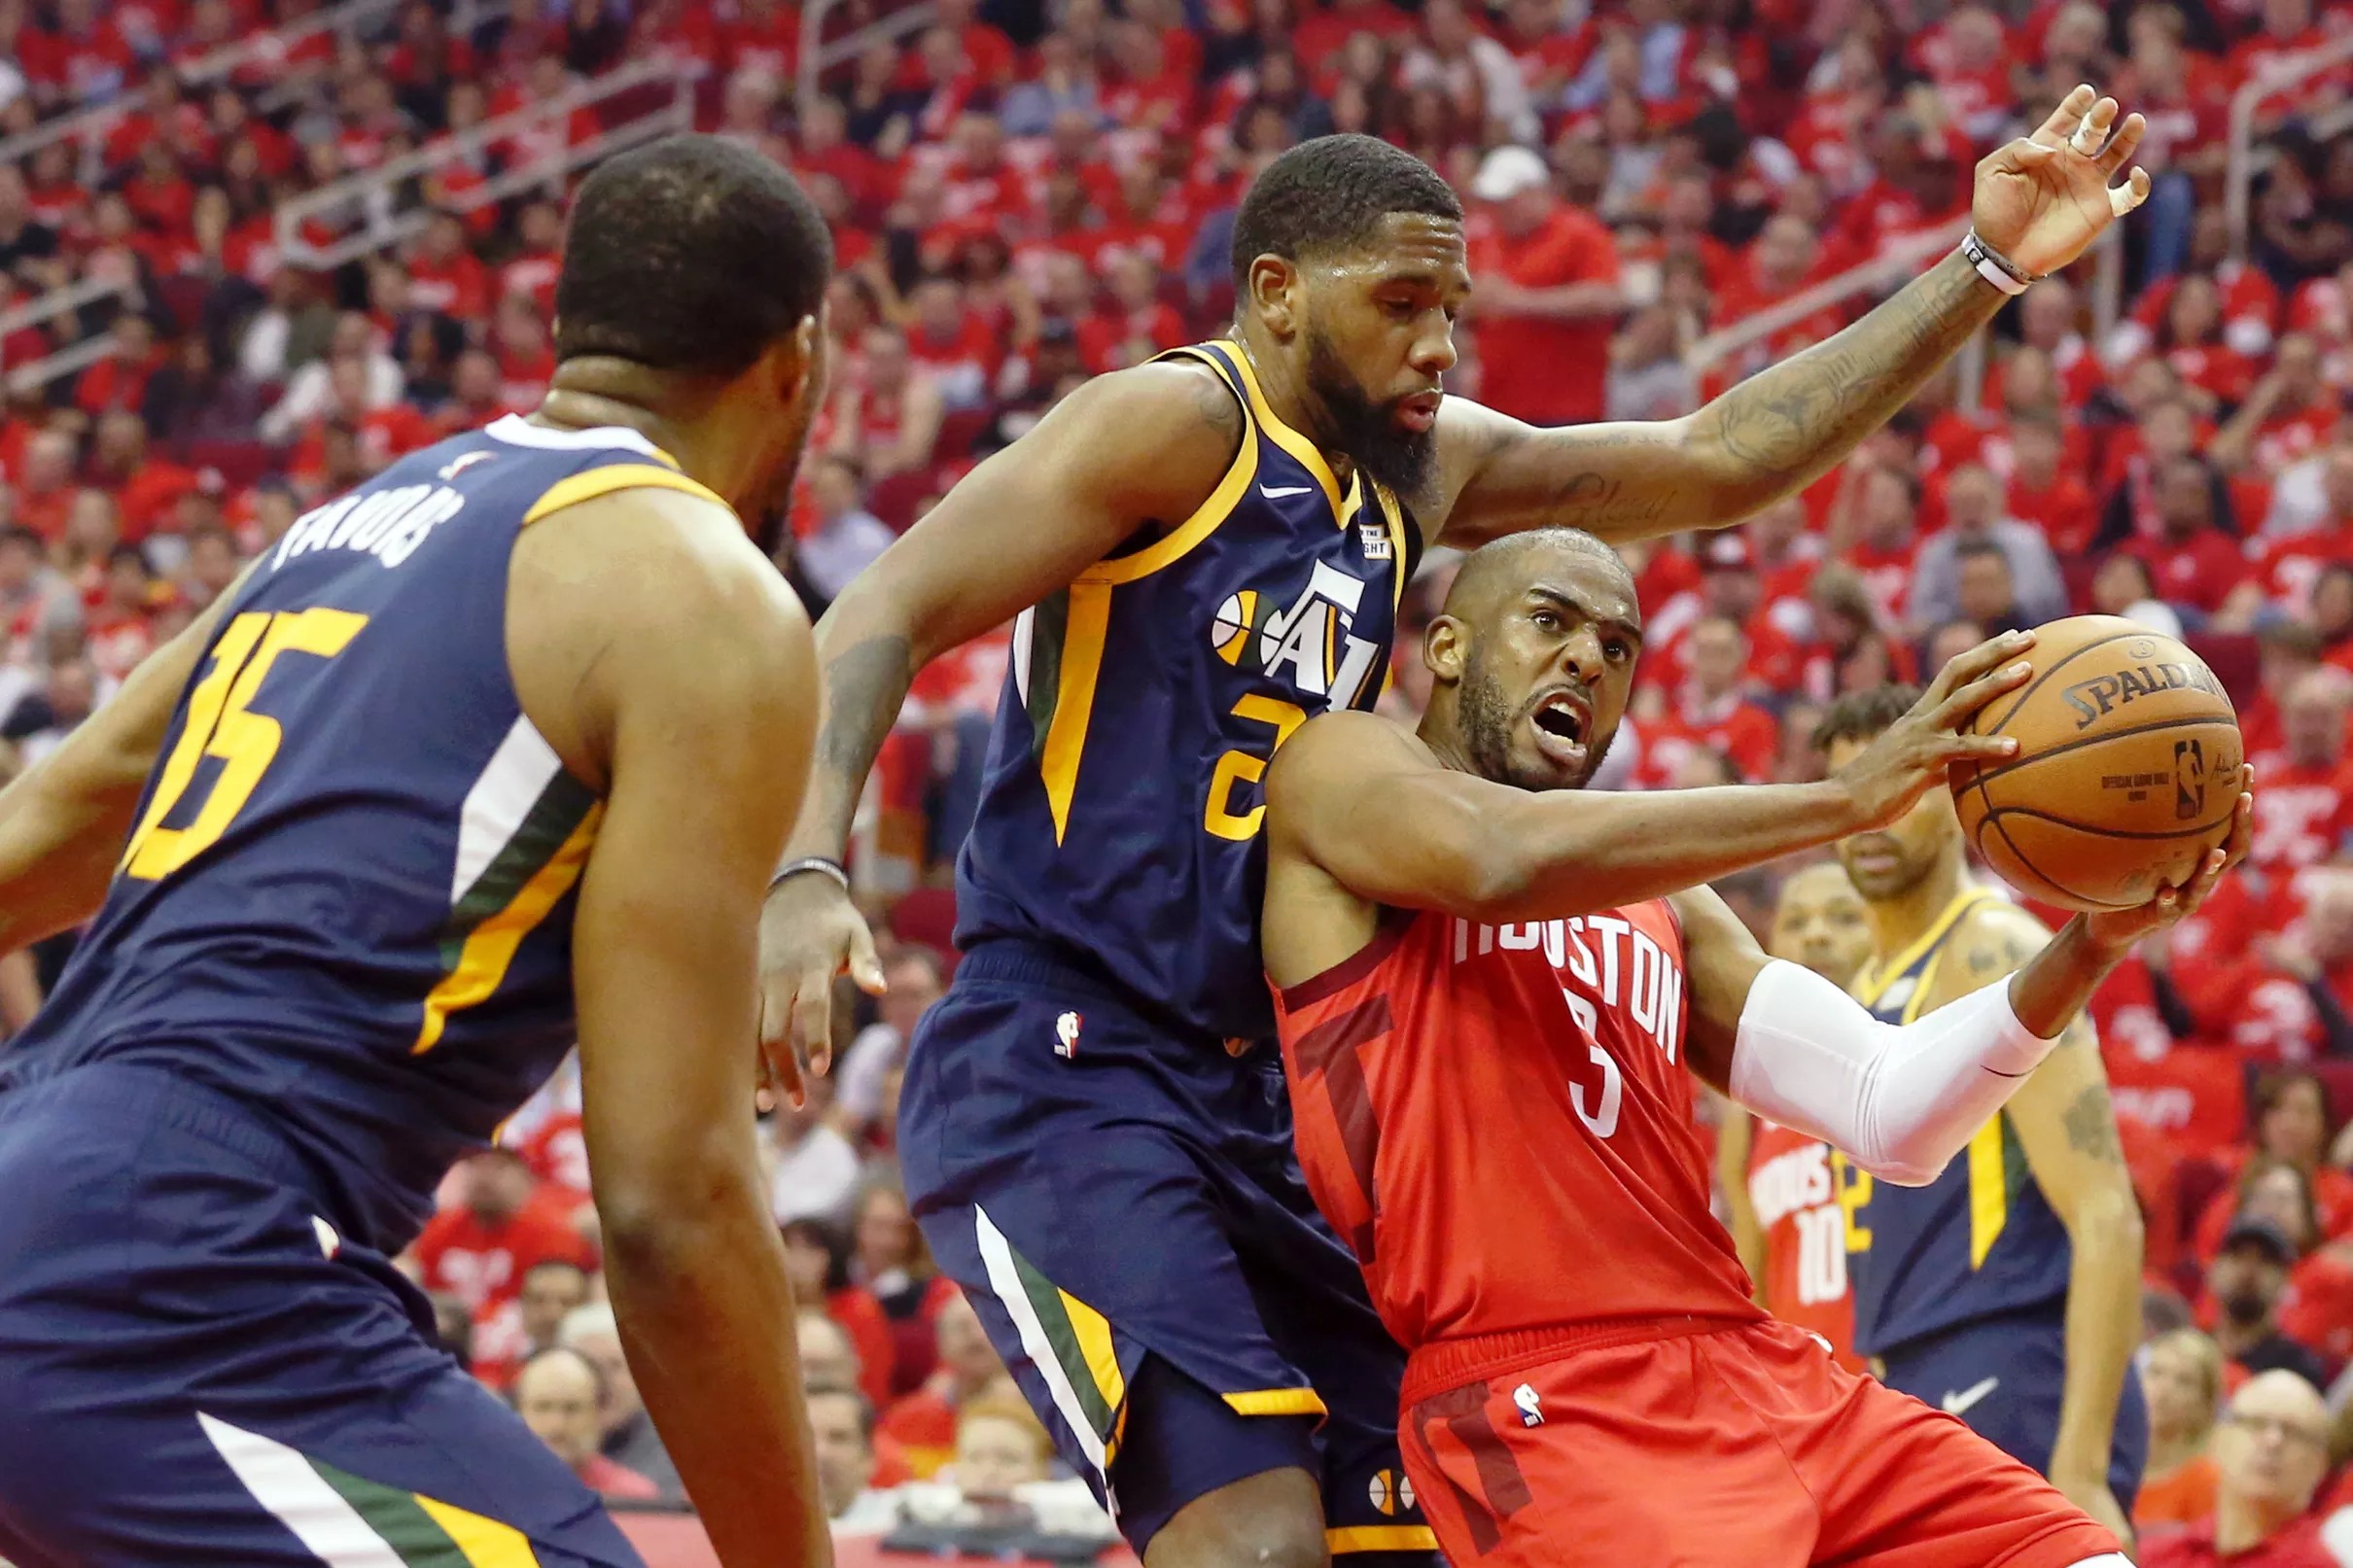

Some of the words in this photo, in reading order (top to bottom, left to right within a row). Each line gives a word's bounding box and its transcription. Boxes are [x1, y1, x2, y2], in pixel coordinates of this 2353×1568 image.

[270, 484, 466, 570] FAVORS
[121, 607, 369, 881] 15
[1562, 987, 1622, 1139] 3
[1793, 1205, 1846, 1305] 10
